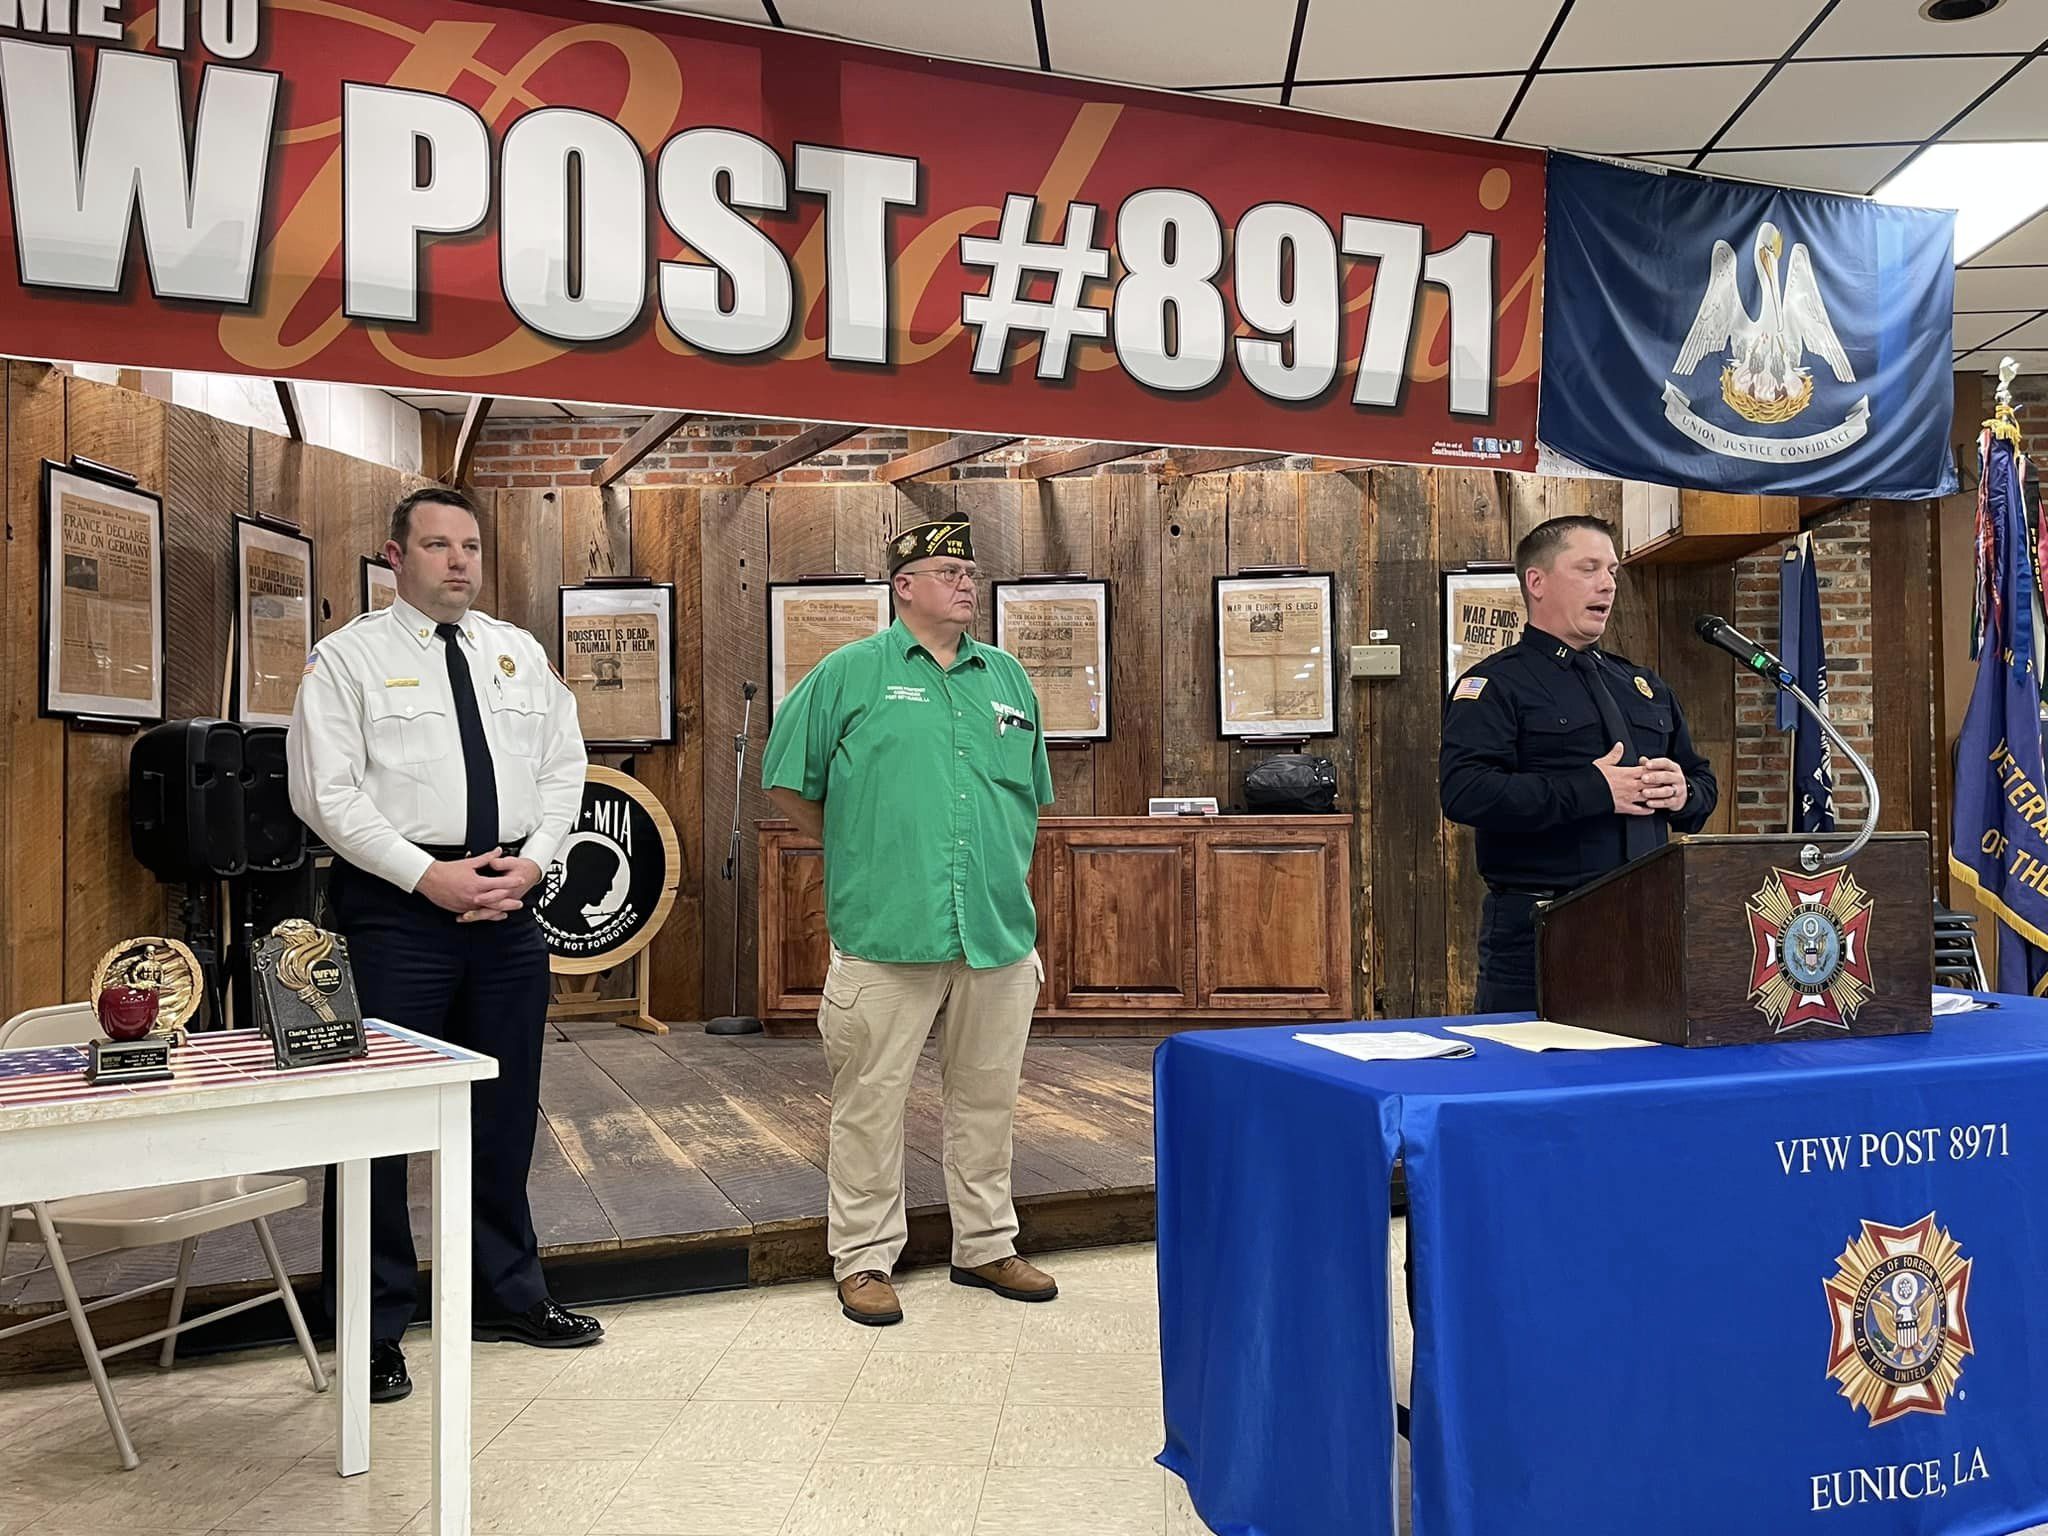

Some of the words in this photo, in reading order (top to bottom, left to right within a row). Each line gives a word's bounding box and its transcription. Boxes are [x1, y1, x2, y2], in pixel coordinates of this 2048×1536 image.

[156, 0, 260, 60] TO
[0, 37, 281, 305] W
[341, 79, 920, 366] POST
[960, 187, 1495, 417] #8971
[1682, 415, 1716, 444] UNION
[1723, 439, 1775, 456] JUSTICE
[1780, 430, 1851, 457] CONFIDENCE
[64, 513, 102, 533] FRANCE
[106, 523, 150, 545] DECLARES
[64, 528, 87, 545] WAR
[90, 534, 104, 549] ON
[108, 538, 150, 559] GERMANY
[946, 539, 963, 548] VFW
[947, 546, 965, 556] 8971
[1227, 603, 1242, 612] WAR
[1245, 603, 1252, 612] IN
[1256, 602, 1281, 611] EUROPE
[1285, 602, 1293, 611] IS
[1296, 602, 1318, 611] ENDED
[1462, 604, 1486, 625] WAR
[1490, 608, 1519, 629] ENDS:
[567, 629, 612, 642] ROOSEVELT
[615, 628, 624, 641] IS
[575, 641, 611, 654] TRUMAN
[616, 640, 627, 652] AT
[632, 639, 655, 652] HELM
[1464, 625, 1497, 646] AGREE
[1501, 629, 1514, 647] TO
[1988, 737, 2048, 845] VETERA
[594, 800, 632, 857] MIA
[1981, 828, 2009, 859] OF
[563, 941, 584, 951] NOT
[588, 911, 639, 949] FORGOTTEN
[1775, 1135, 1852, 1175] VFW
[1859, 1127, 1941, 1168] POST
[1949, 1122, 2010, 1161] 8971
[1854, 1269, 1885, 1320] VETERANS
[1887, 1258, 1900, 1271] OF
[1903, 1256, 1934, 1280] FOREIGN
[1933, 1278, 1946, 1309] WARS
[1857, 1338, 1871, 1353] OF
[1867, 1357, 1888, 1375] THE
[1894, 1366, 1926, 1382] UNITED
[1930, 1326, 1946, 1366] STATES
[1810, 1458, 1948, 1512] EUNICE,
[1953, 1445, 1991, 1487] LA
